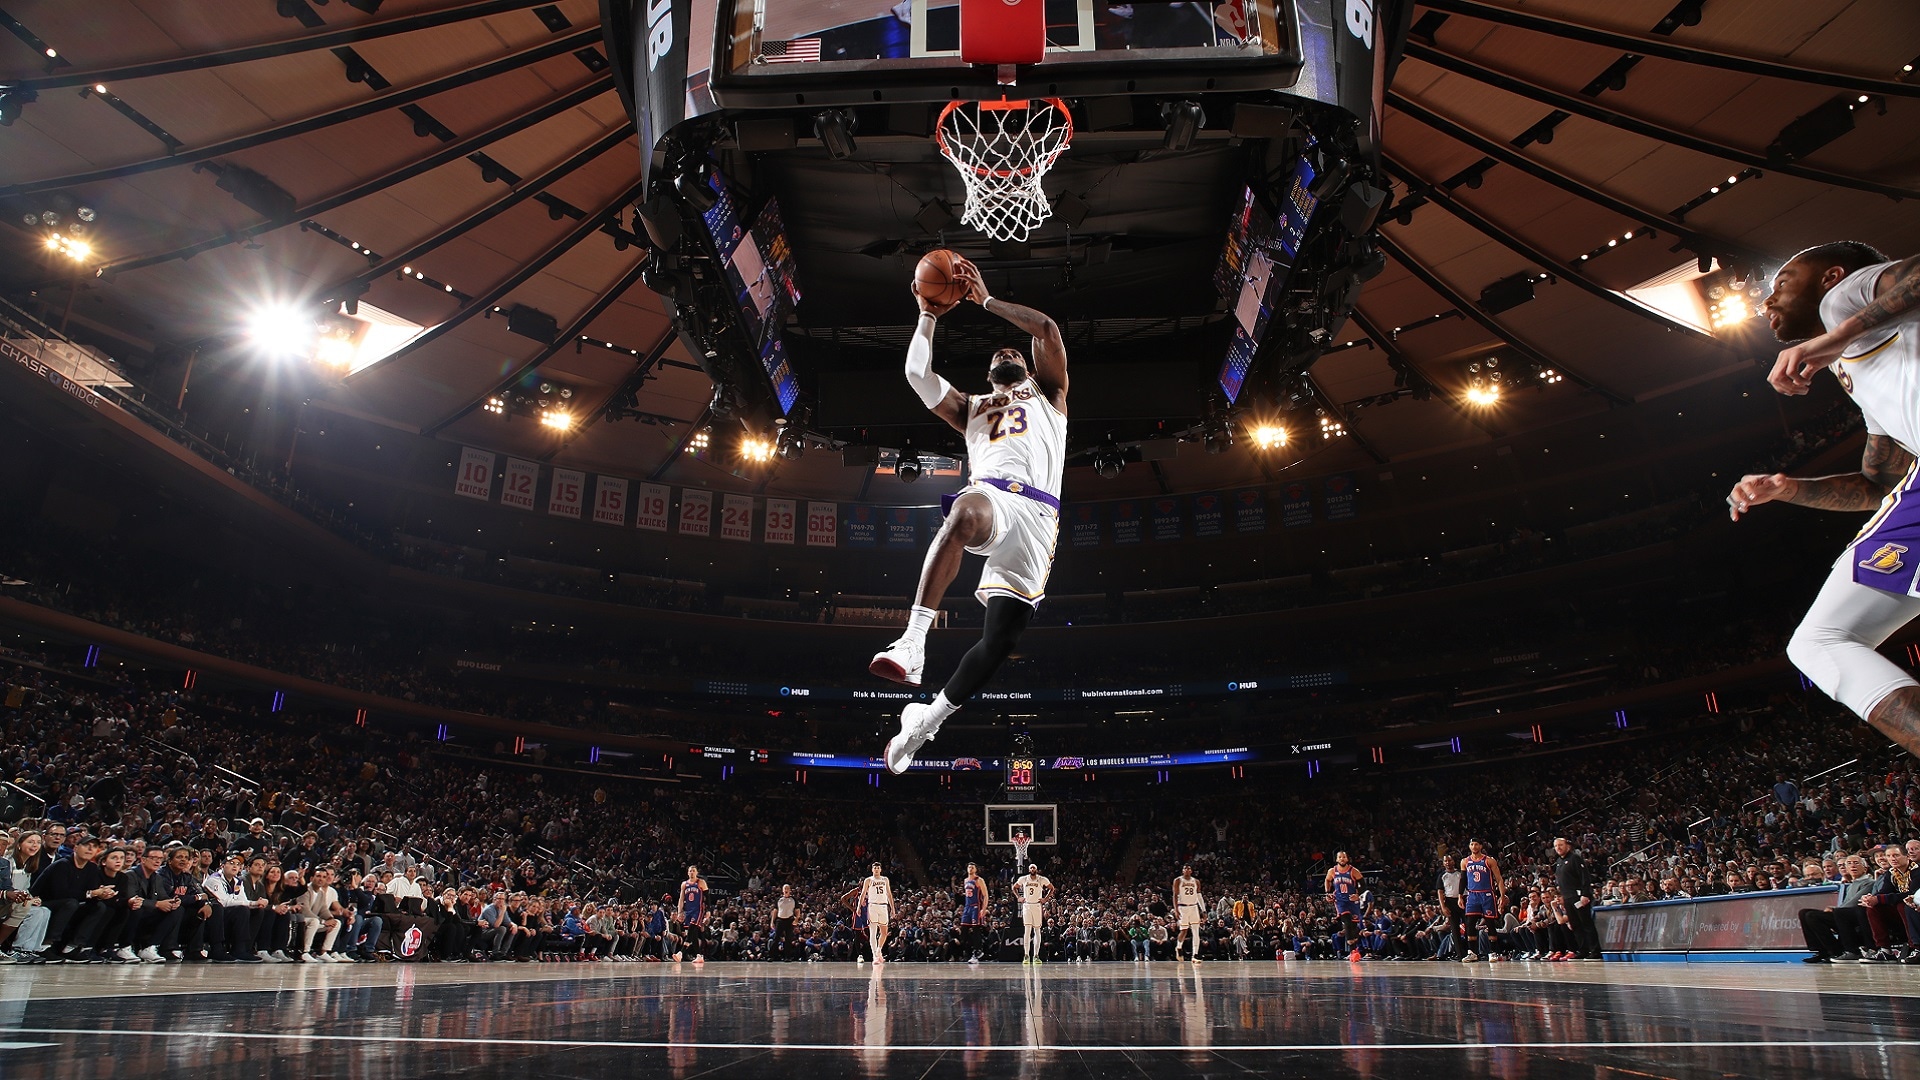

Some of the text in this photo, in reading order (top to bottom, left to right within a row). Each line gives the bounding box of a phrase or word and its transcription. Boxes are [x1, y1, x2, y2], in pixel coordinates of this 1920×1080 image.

[1, 343, 99, 408] CHASE BRIDGE
[987, 407, 1028, 441] 23
[464, 463, 487, 483] 10
[457, 482, 488, 496] KNICKS
[509, 473, 532, 494] 12
[556, 483, 578, 503] 15
[600, 489, 622, 509] 15
[503, 493, 533, 507] KNICKS
[1327, 495, 1353, 504] 2012-13
[550, 503, 580, 515] KNICKS
[643, 497, 664, 516] 19
[683, 502, 709, 522] 22
[595, 510, 623, 522] KNICKS
[724, 507, 749, 526] 24
[768, 511, 793, 530] 33
[638, 517, 666, 528] KNICKS
[681, 522, 709, 533] KNICKS
[808, 514, 837, 533] 613
[722, 527, 750, 538] KNICKS
[766, 532, 794, 541] KNICKS
[808, 534, 835, 544] KNICKS
[1512, 652, 1540, 662] LIGHT
[456, 659, 502, 672] BUD LIGHT
[1239, 681, 1258, 689] HUB
[791, 688, 810, 697] HUB
[853, 690, 868, 698] Risk
[877, 691, 913, 699] Insurance
[982, 692, 1032, 700] Private Client
[1082, 689, 1163, 698] hubinternational.com
[992, 759, 999, 767] 4
[1013, 760, 1034, 770] 8:50
[1039, 759, 1046, 767] 2
[1099, 758, 1125, 766] ANGELES
[1126, 757, 1149, 765] LAKERS
[1011, 770, 1031, 784] 20
[1473, 871, 1481, 883] 3
[875, 886, 884, 895] 15
[1029, 888, 1035, 896] 3
[1185, 888, 1194, 896] 28
[1605, 912, 1668, 943] GET THE APP
[1699, 922, 1729, 932] Powered
[1730, 921, 1740, 933] by
